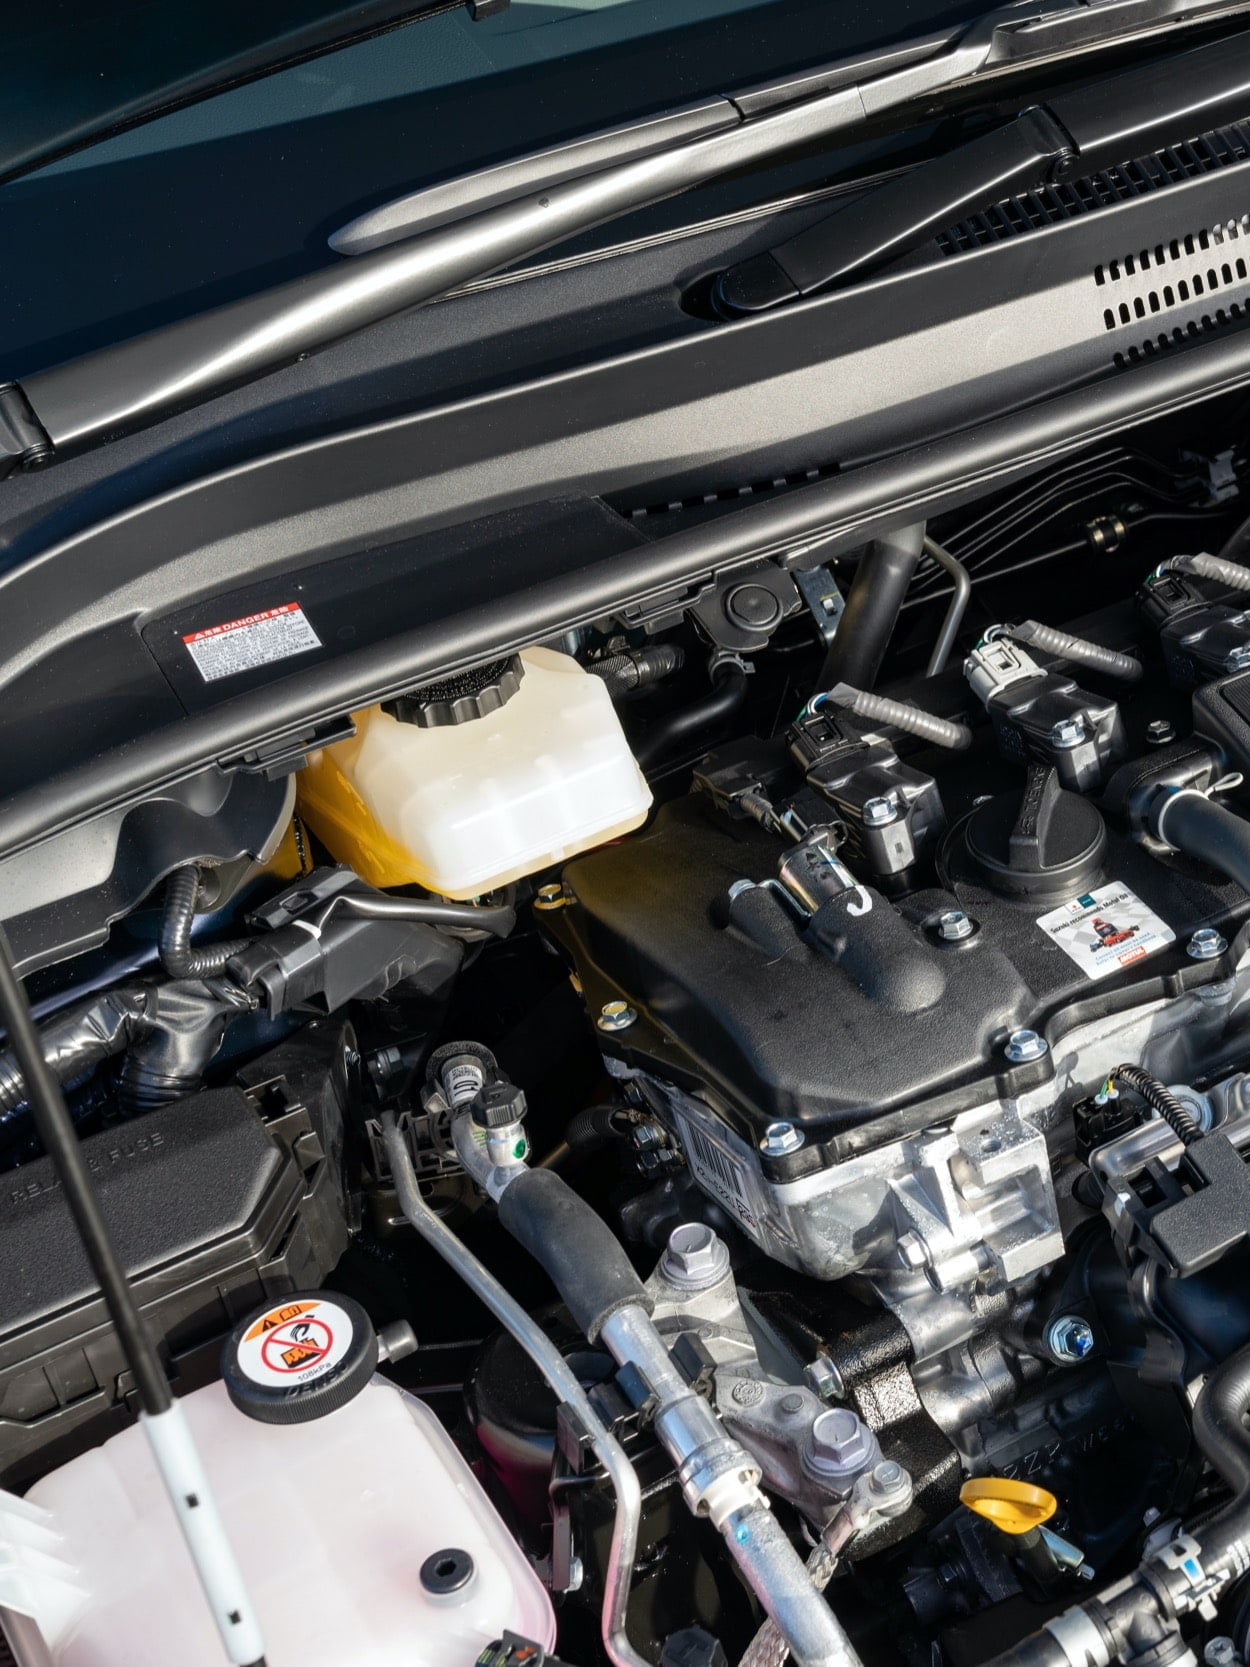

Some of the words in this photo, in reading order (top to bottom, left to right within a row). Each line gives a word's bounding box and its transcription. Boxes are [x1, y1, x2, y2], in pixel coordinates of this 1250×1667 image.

[223, 612, 270, 631] DANGER
[1050, 921, 1070, 934] Suzuki
[1069, 905, 1104, 926] recommends
[1103, 897, 1120, 910] Motul
[1120, 947, 1145, 962] MOTUL
[110, 1132, 164, 1164] FUSE
[298, 1362, 332, 1382] 108kPa
